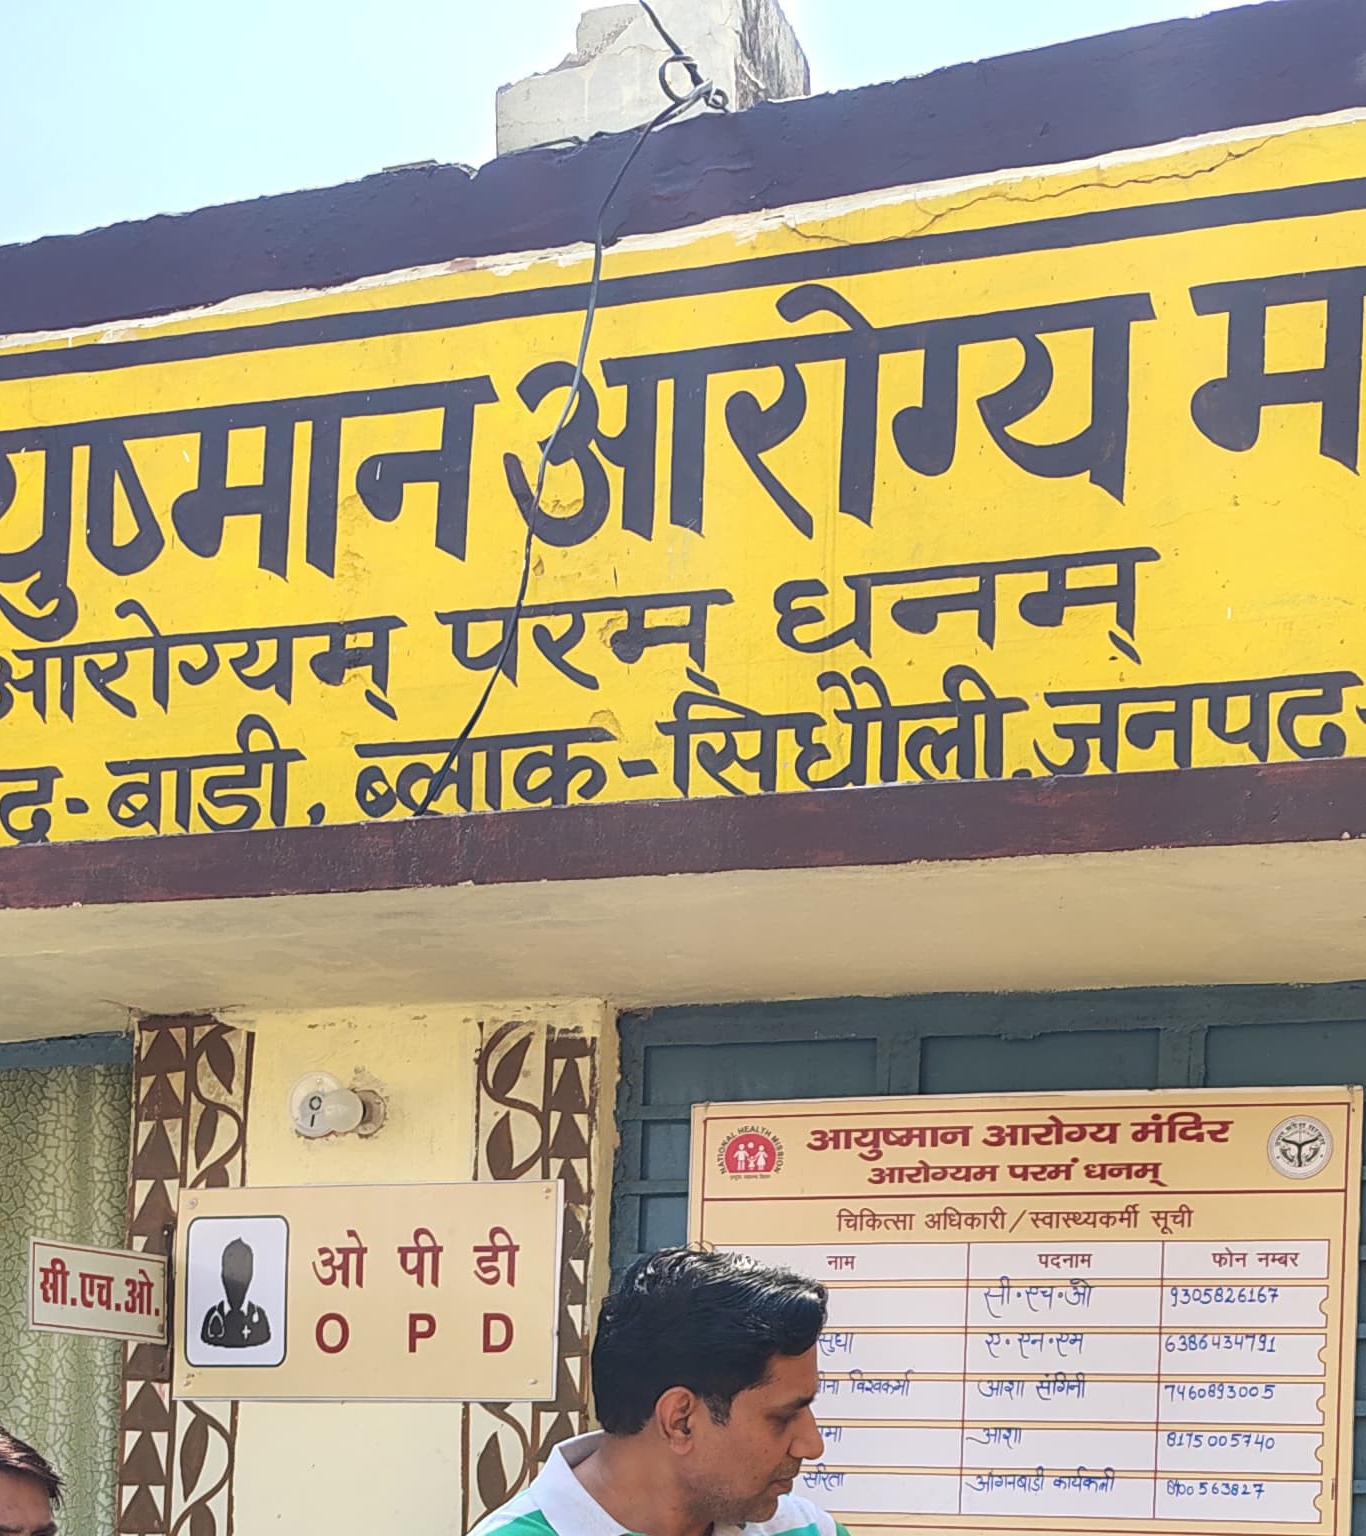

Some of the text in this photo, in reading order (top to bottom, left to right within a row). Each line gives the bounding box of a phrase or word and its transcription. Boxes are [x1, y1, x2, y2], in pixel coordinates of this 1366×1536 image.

[502, 282, 1153, 546] आरोग्य
[436, 588, 732, 697] परम्
[773, 545, 1161, 664] धनम्
[716, 1125, 784, 1175] NATIONAL HEALTH MISSION
[806, 1112, 1234, 1161] आयुष्मान आरोग्य मंदिर
[867, 1160, 1000, 1184] आरोग्यम
[1083, 1162, 1168, 1187] धनम्
[836, 1207, 916, 1232] चिकित्सा
[1151, 1204, 1194, 1234] सूची
[312, 1226, 520, 1288] ओ पी डी
[827, 1256, 856, 1270] नाम
[1037, 1253, 1093, 1268] पदनाम
[1212, 1249, 1300, 1268] फोन नम्बर
[1170, 1286, 1279, 1307] 9305826167
[315, 1313, 514, 1354] O P D
[1165, 1334, 1276, 1352] 6386434791
[1164, 1384, 1276, 1402] 7460893005
